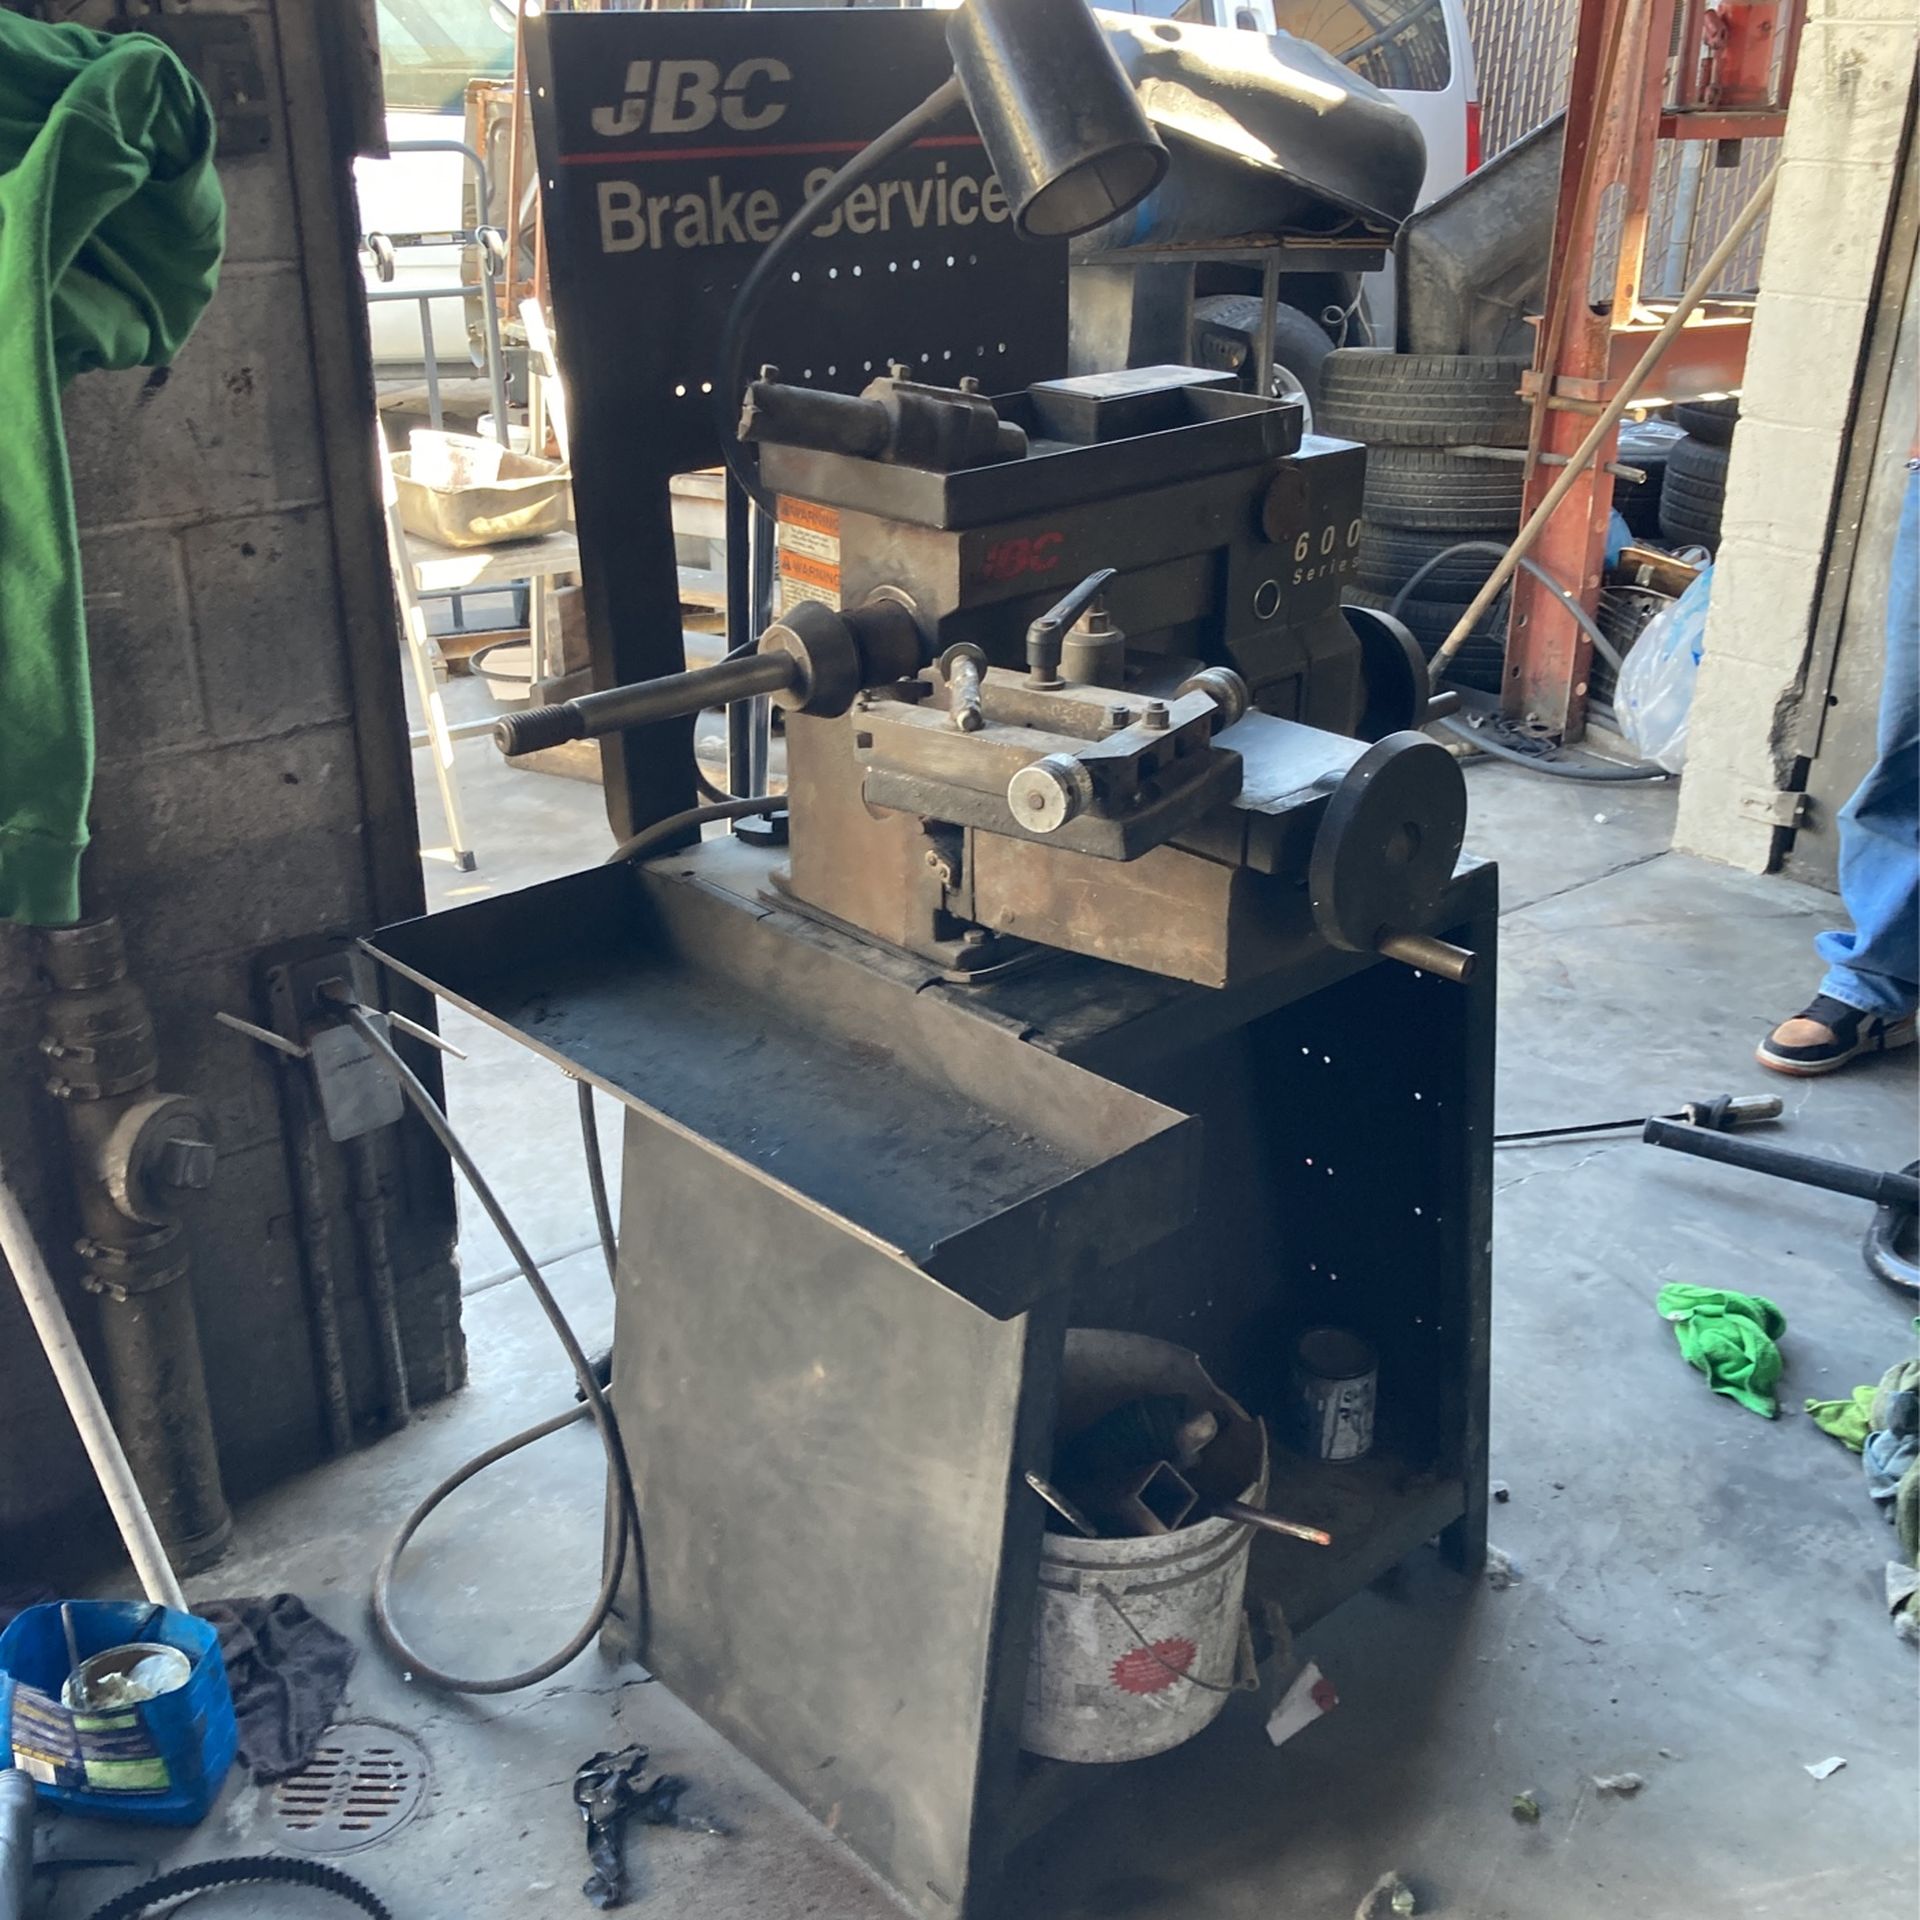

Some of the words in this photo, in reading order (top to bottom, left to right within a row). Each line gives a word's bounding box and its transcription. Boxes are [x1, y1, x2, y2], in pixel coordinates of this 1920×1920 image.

[591, 57, 793, 137] JBC
[597, 175, 781, 253] Brake
[803, 160, 1010, 238] Service
[1292, 556, 1360, 585] Series
[1294, 518, 1361, 562] 600
